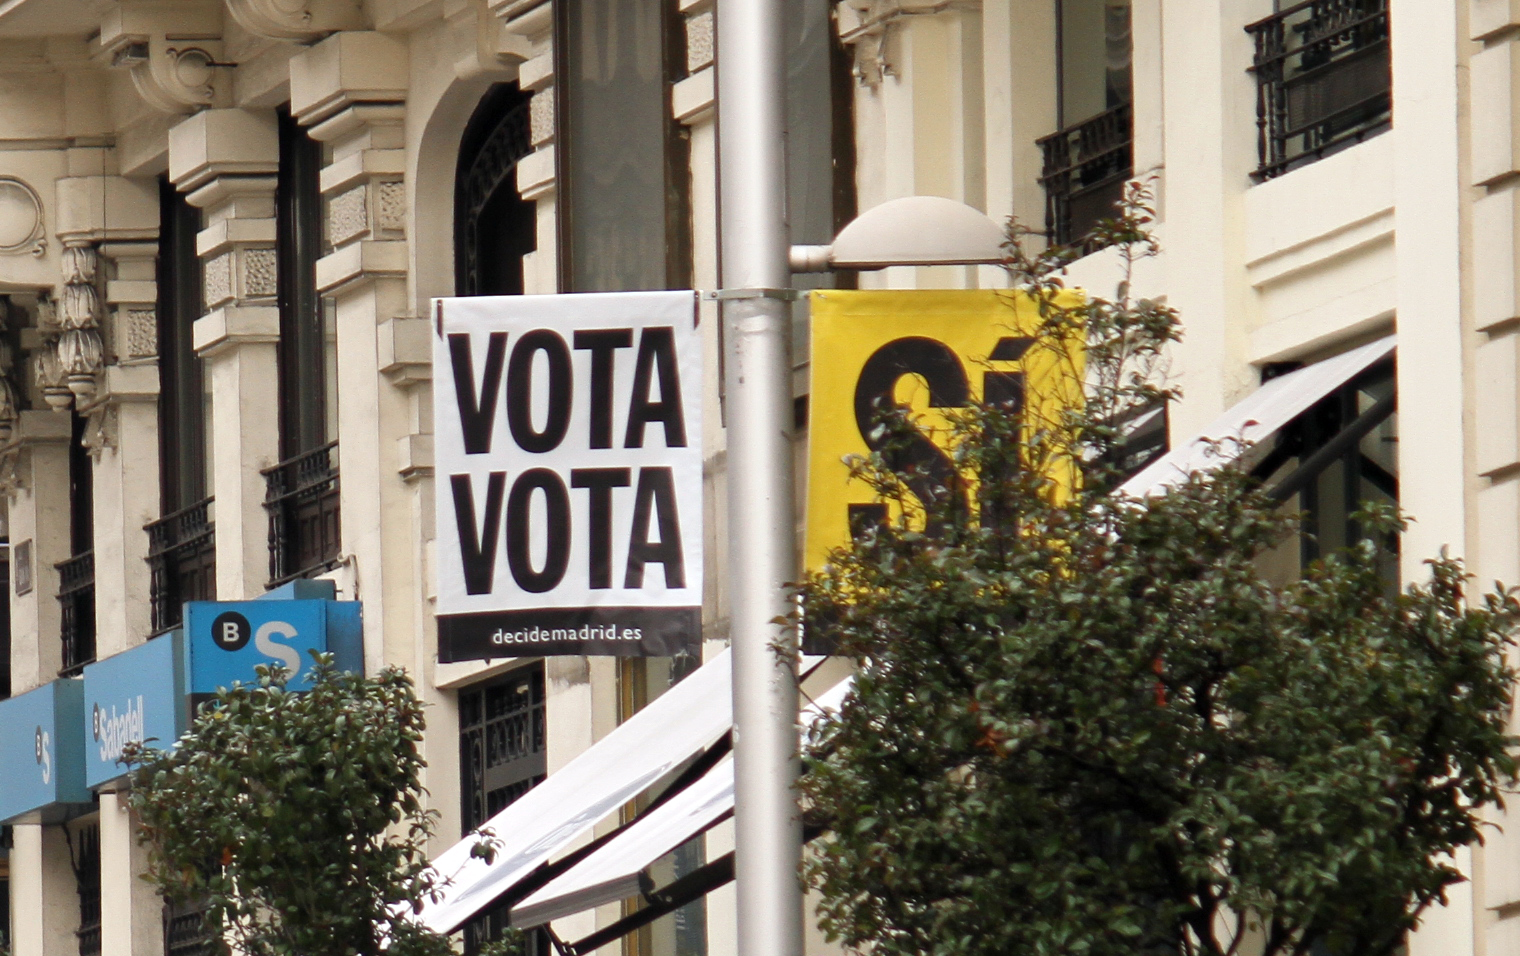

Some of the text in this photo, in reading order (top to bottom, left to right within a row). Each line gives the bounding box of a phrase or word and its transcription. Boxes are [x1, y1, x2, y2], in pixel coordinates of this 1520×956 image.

[448, 326, 688, 455] VOTA
[450, 466, 686, 596] VOTA
[492, 623, 642, 645] decidemadrid.es
